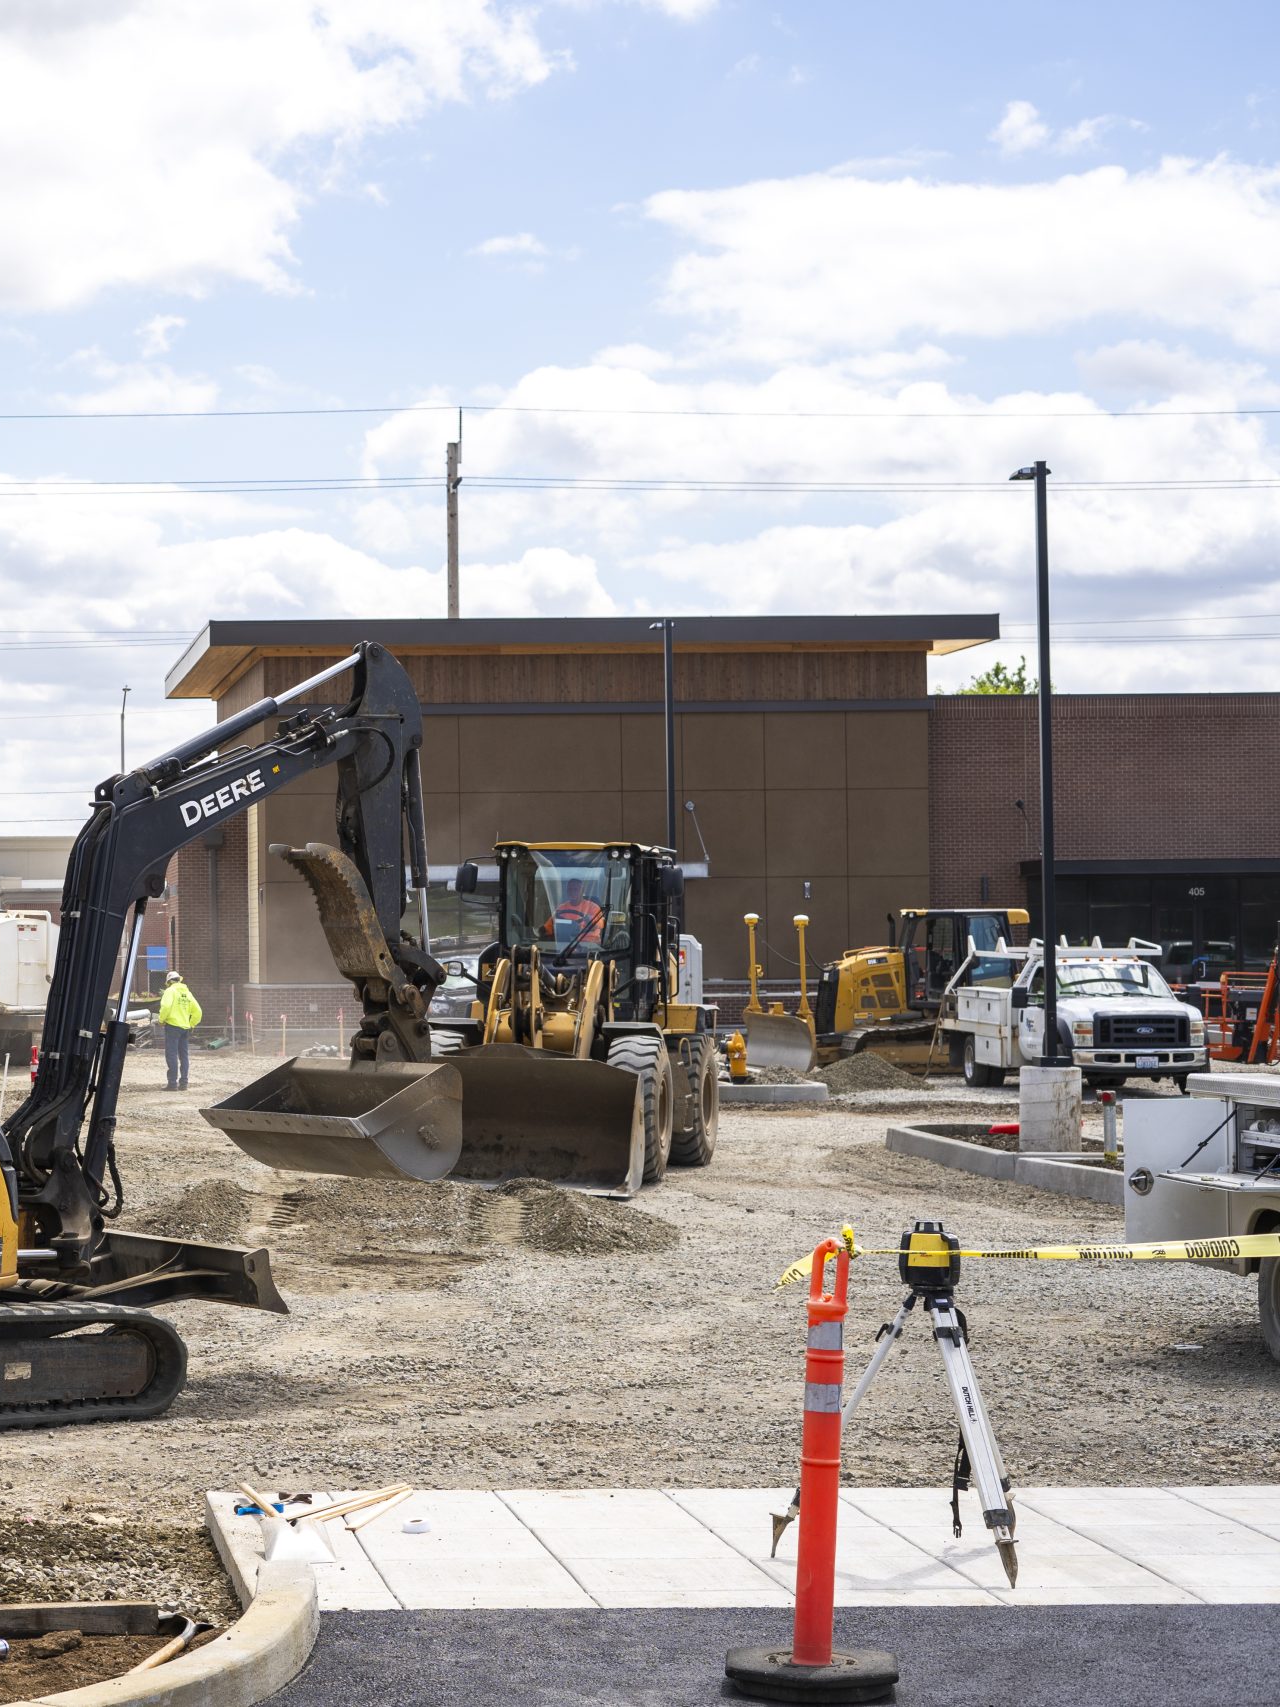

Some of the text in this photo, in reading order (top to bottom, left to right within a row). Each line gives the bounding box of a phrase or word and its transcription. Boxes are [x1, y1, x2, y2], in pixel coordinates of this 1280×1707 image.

[179, 768, 266, 828] DEERE
[1188, 887, 1205, 896] 405
[1183, 1239, 1240, 1259] CUIDADO
[961, 1386, 976, 1418] DUTCH HILL
